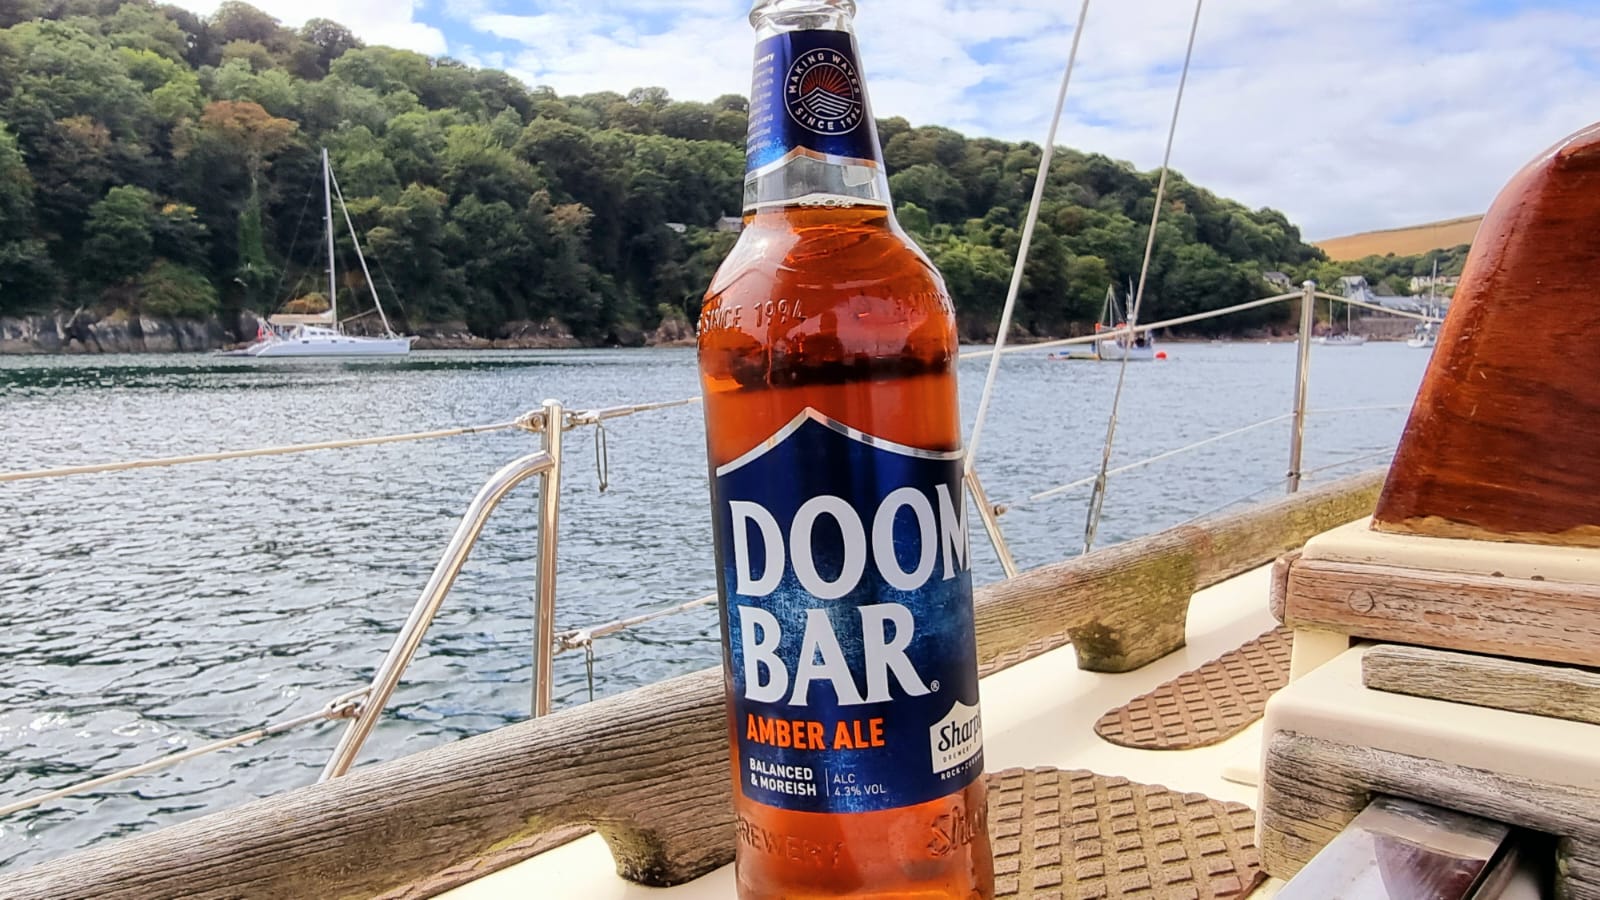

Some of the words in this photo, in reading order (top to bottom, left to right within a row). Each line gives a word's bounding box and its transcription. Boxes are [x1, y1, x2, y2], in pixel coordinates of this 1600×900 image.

[788, 53, 825, 94] MAKING
[831, 54, 860, 94] WAVES
[795, 107, 835, 131] SINCE
[840, 106, 862, 129] 1994
[703, 305, 742, 333] SINCE
[754, 299, 808, 328] 1994
[729, 476, 971, 600] DOOM
[737, 603, 932, 706] BAR
[746, 713, 826, 750] AMBER
[833, 717, 885, 750] ALE
[749, 757, 814, 781] BALANCED
[833, 773, 856, 785] ALC
[941, 767, 961, 780] ROCK
[750, 772, 758, 787] &
[760, 776, 817, 797] MOREISH
[834, 784, 862, 797] 4.3%
[863, 784, 888, 795] VOL
